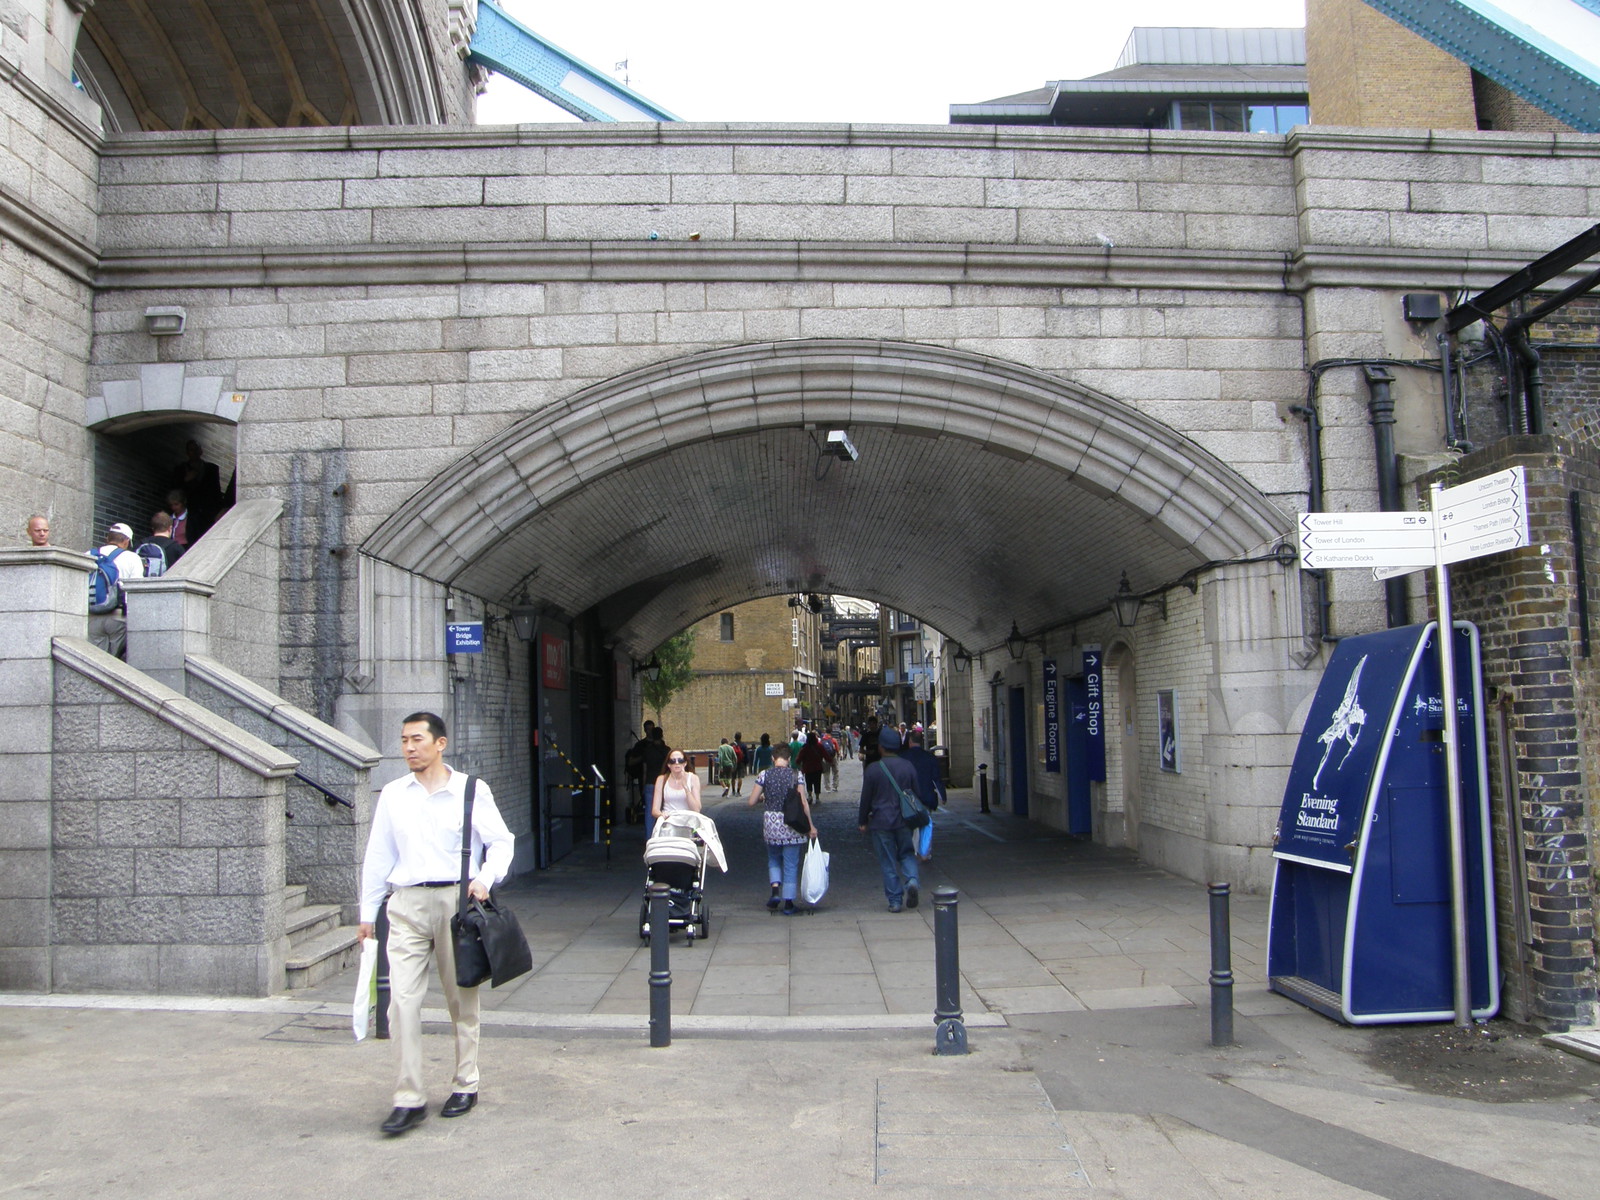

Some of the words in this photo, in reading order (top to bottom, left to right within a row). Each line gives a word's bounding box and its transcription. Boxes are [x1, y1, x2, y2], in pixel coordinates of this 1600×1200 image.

[1482, 500, 1497, 509] London
[1497, 497, 1511, 506] Bridge
[1473, 522, 1489, 531] Thames
[1489, 519, 1498, 527] Path
[1470, 544, 1480, 552] More
[1480, 541, 1495, 551] London
[1495, 536, 1514, 546] Riverside
[1087, 673, 1100, 698] Gift
[1046, 680, 1057, 719] Engine
[1428, 697, 1463, 705] Eveg
[1428, 704, 1468, 712] Stard
[1087, 701, 1100, 736] Shop
[1048, 722, 1058, 762] Rooms
[1300, 792, 1338, 814] Evening
[1296, 810, 1340, 830] Standard
